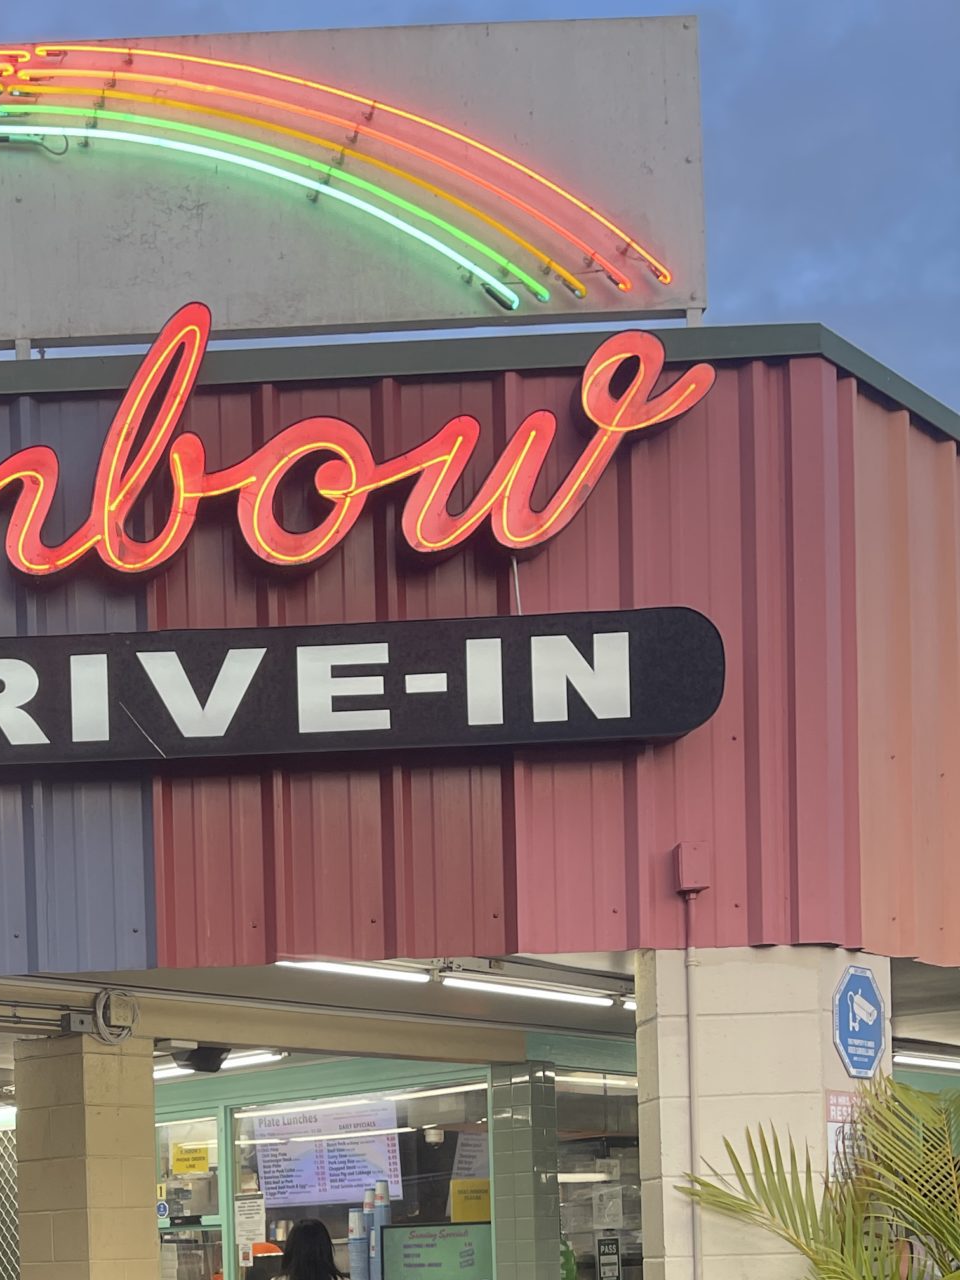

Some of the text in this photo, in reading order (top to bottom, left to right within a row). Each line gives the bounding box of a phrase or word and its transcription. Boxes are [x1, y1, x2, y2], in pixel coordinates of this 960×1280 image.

[258, 1115, 280, 1128] Plate
[282, 1113, 318, 1126] Lunches
[600, 1244, 617, 1254] PASS
